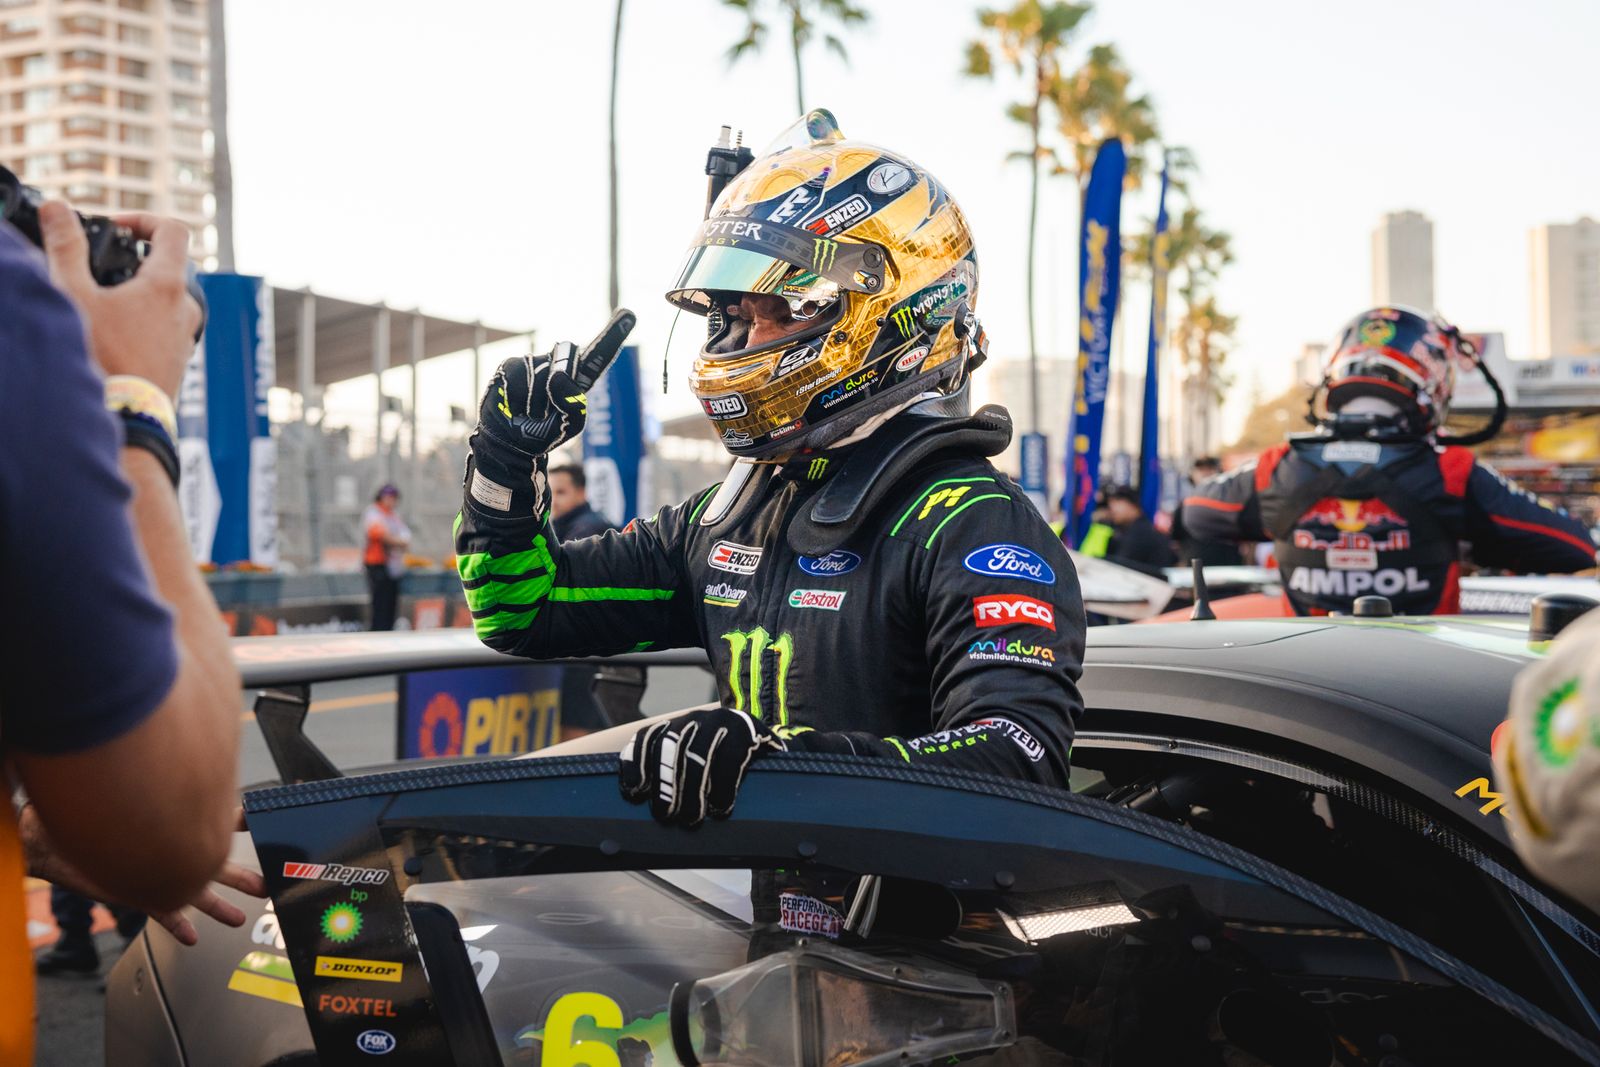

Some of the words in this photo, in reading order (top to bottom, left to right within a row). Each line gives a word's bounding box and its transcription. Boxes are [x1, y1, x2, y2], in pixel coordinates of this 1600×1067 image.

[824, 199, 866, 228] ENZED
[704, 220, 762, 241] STER
[912, 272, 967, 317] MONSTER
[902, 351, 924, 367] BELL
[820, 369, 879, 404] mildura
[823, 377, 879, 409] visitmildura.com.au
[711, 397, 741, 414] ENZED
[728, 552, 761, 567] ENZED
[811, 553, 847, 572] Ford
[987, 547, 1043, 578] Ford
[1288, 566, 1430, 596] AMPOL
[801, 591, 840, 609] Castrol
[976, 600, 1053, 624] RYCO
[968, 638, 1055, 662] mildura
[969, 652, 1053, 668] visitmildura.com.au
[915, 733, 989, 755] NERGY
[321, 863, 390, 886] Repco
[350, 888, 369, 903] bp
[332, 963, 398, 976] DUNLOP
[318, 994, 398, 1018] FOXTEL
[541, 991, 624, 1067] 6
[364, 1034, 388, 1049] FOX
